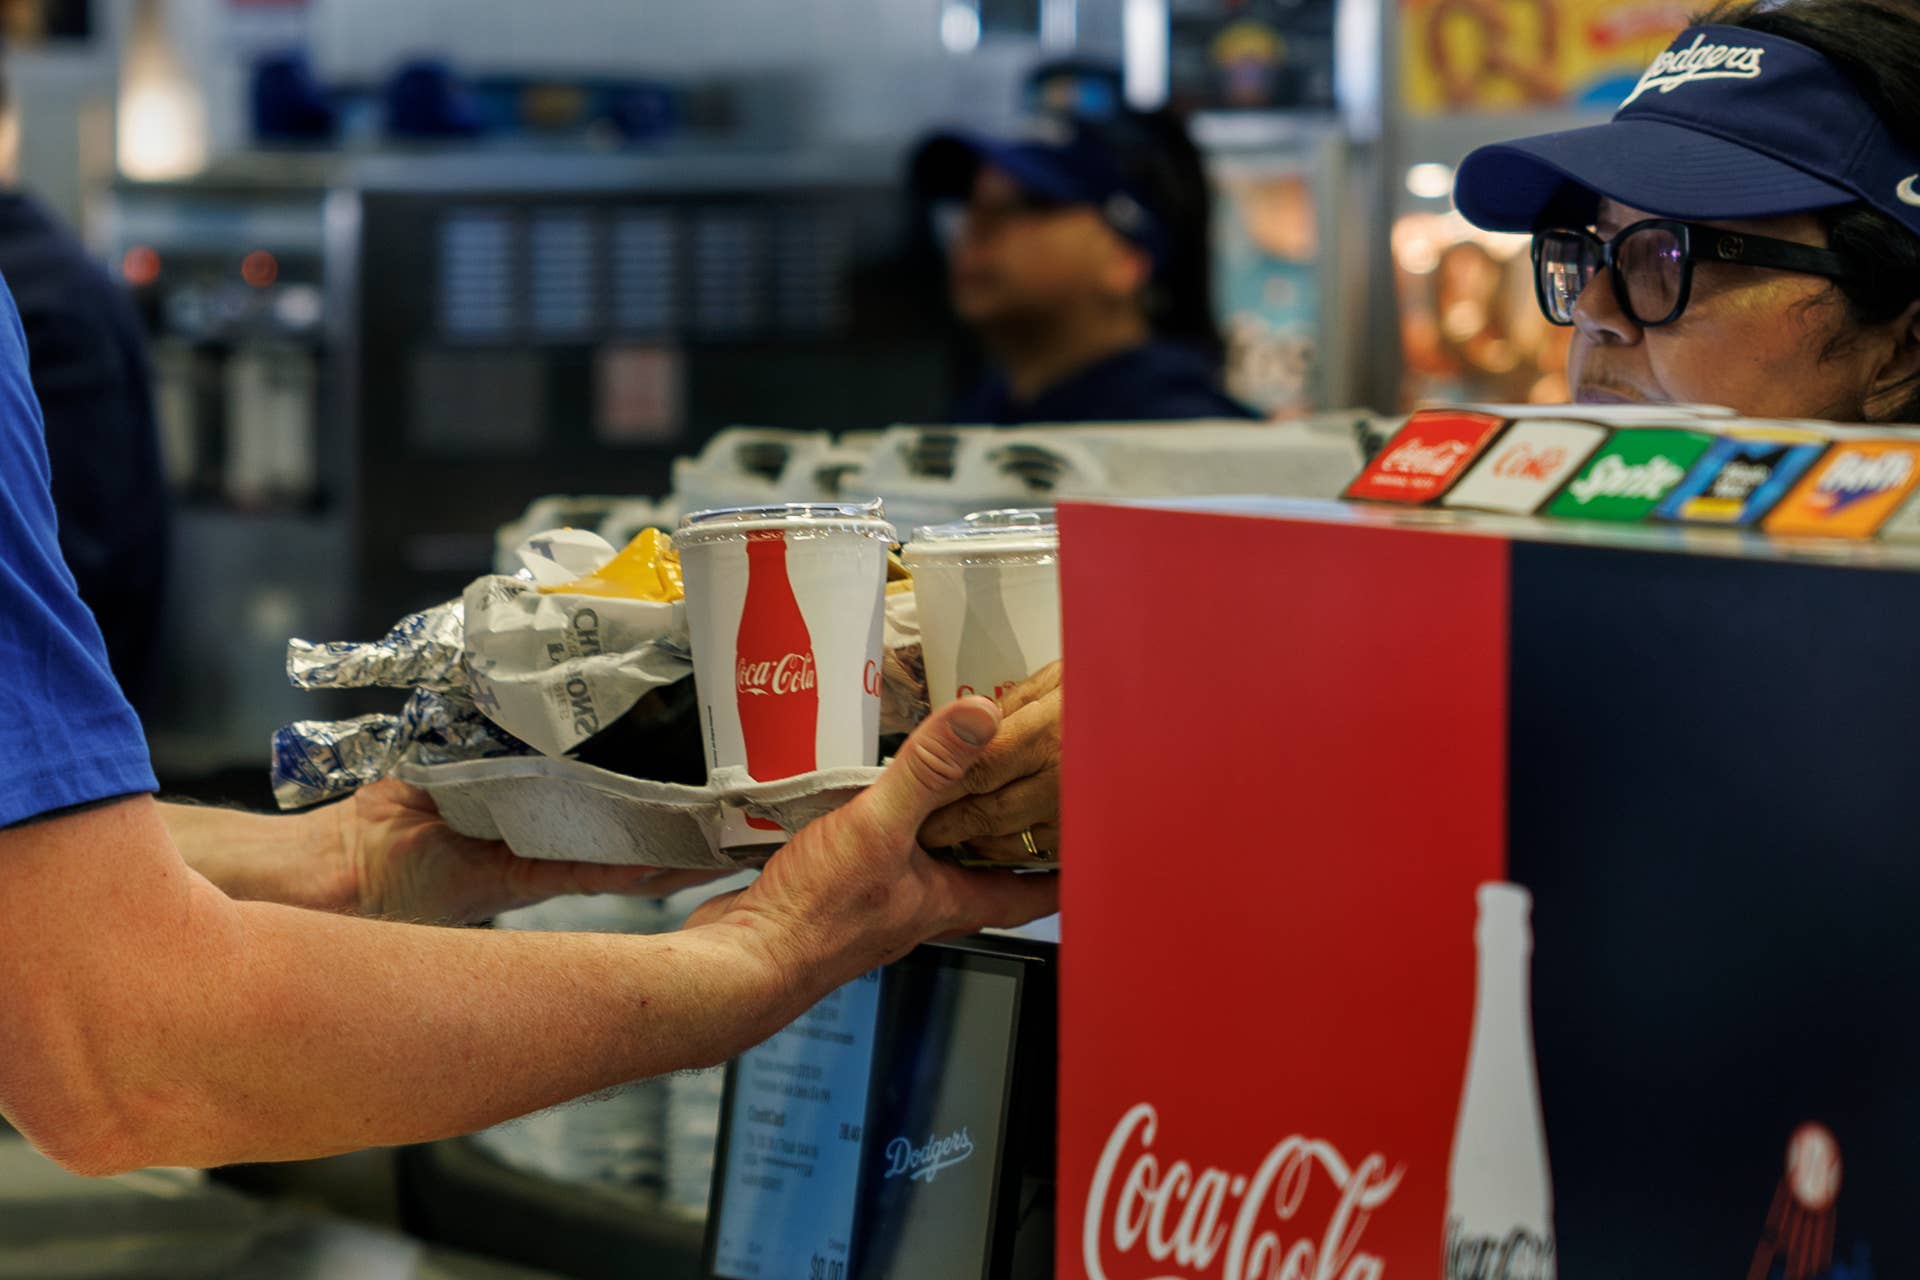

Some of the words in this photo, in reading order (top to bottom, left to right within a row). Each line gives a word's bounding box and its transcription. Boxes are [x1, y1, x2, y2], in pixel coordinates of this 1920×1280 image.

[1569, 453, 1686, 505] Sprite
[884, 1124, 973, 1184] Dodgers
[1082, 1101, 1407, 1280] Coca-Cl
